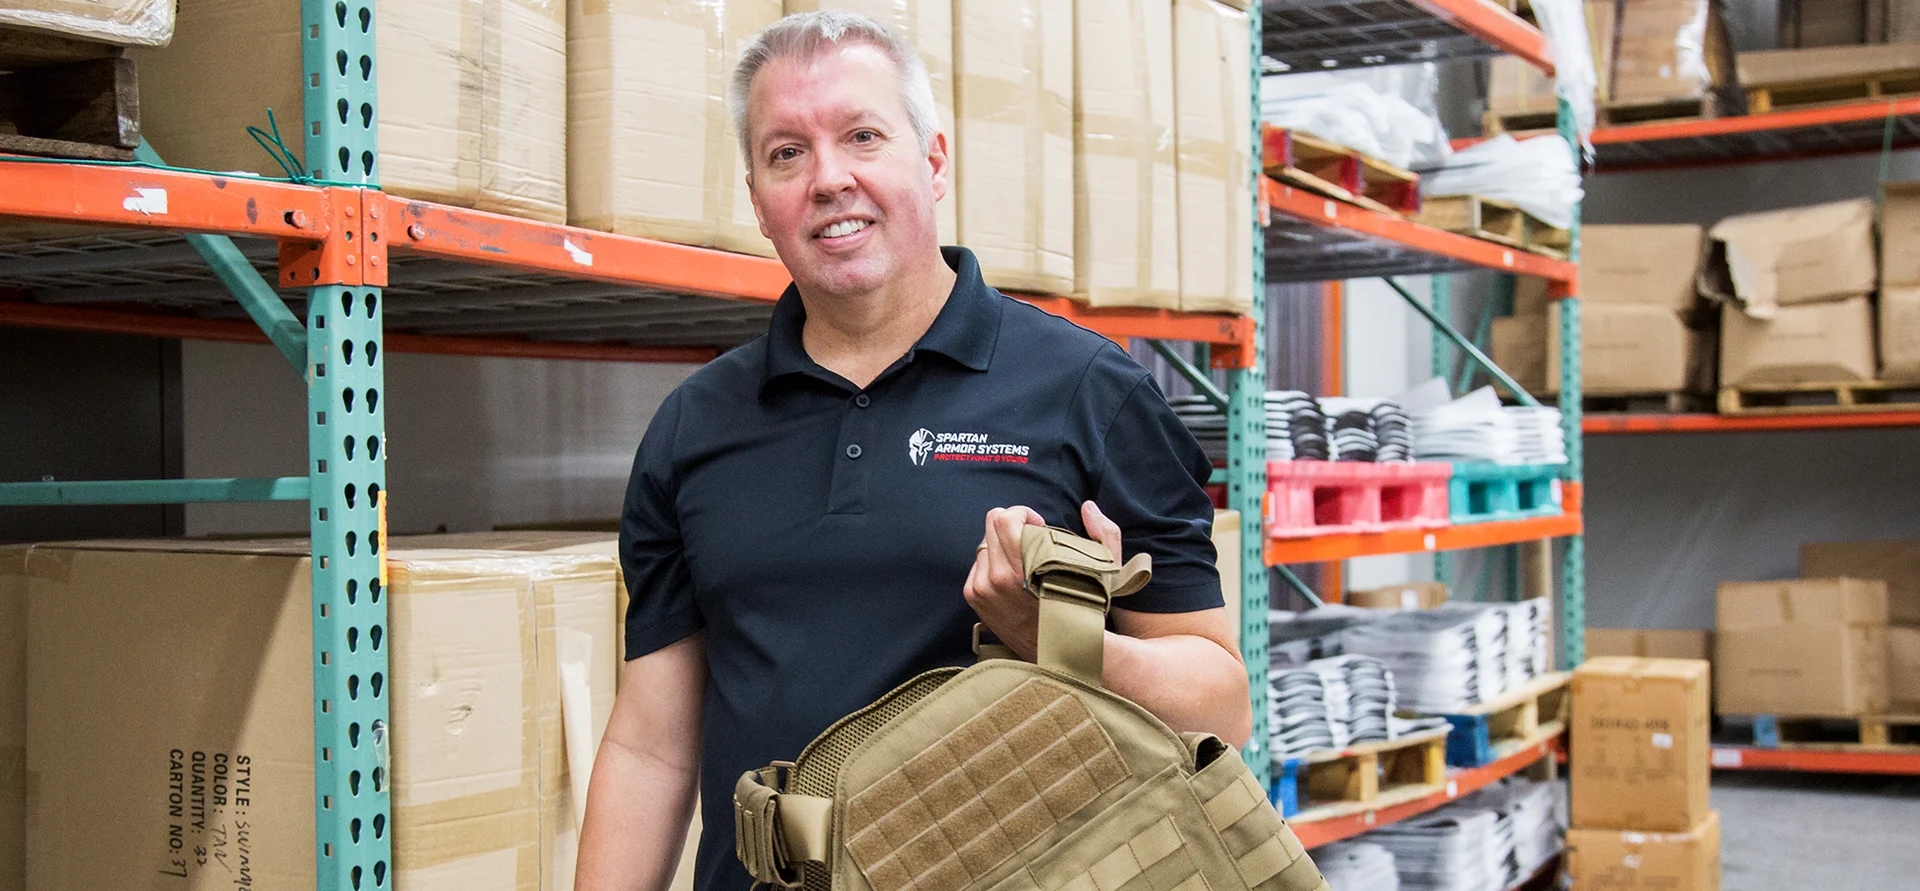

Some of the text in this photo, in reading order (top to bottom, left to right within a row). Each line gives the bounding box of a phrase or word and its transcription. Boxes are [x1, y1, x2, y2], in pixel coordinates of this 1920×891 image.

[935, 433, 988, 443] SPARTAN
[935, 443, 1030, 455] ARMOR SYSTEMS
[971, 454, 1000, 462] WHAT'S
[1001, 455, 1028, 464] YOURS
[169, 749, 184, 817] CARTON
[236, 755, 251, 815] STYLE:
[191, 751, 208, 868] QUANTITY: 32
[210, 753, 233, 873] COLOR: TAN
[169, 825, 184, 854] NO:
